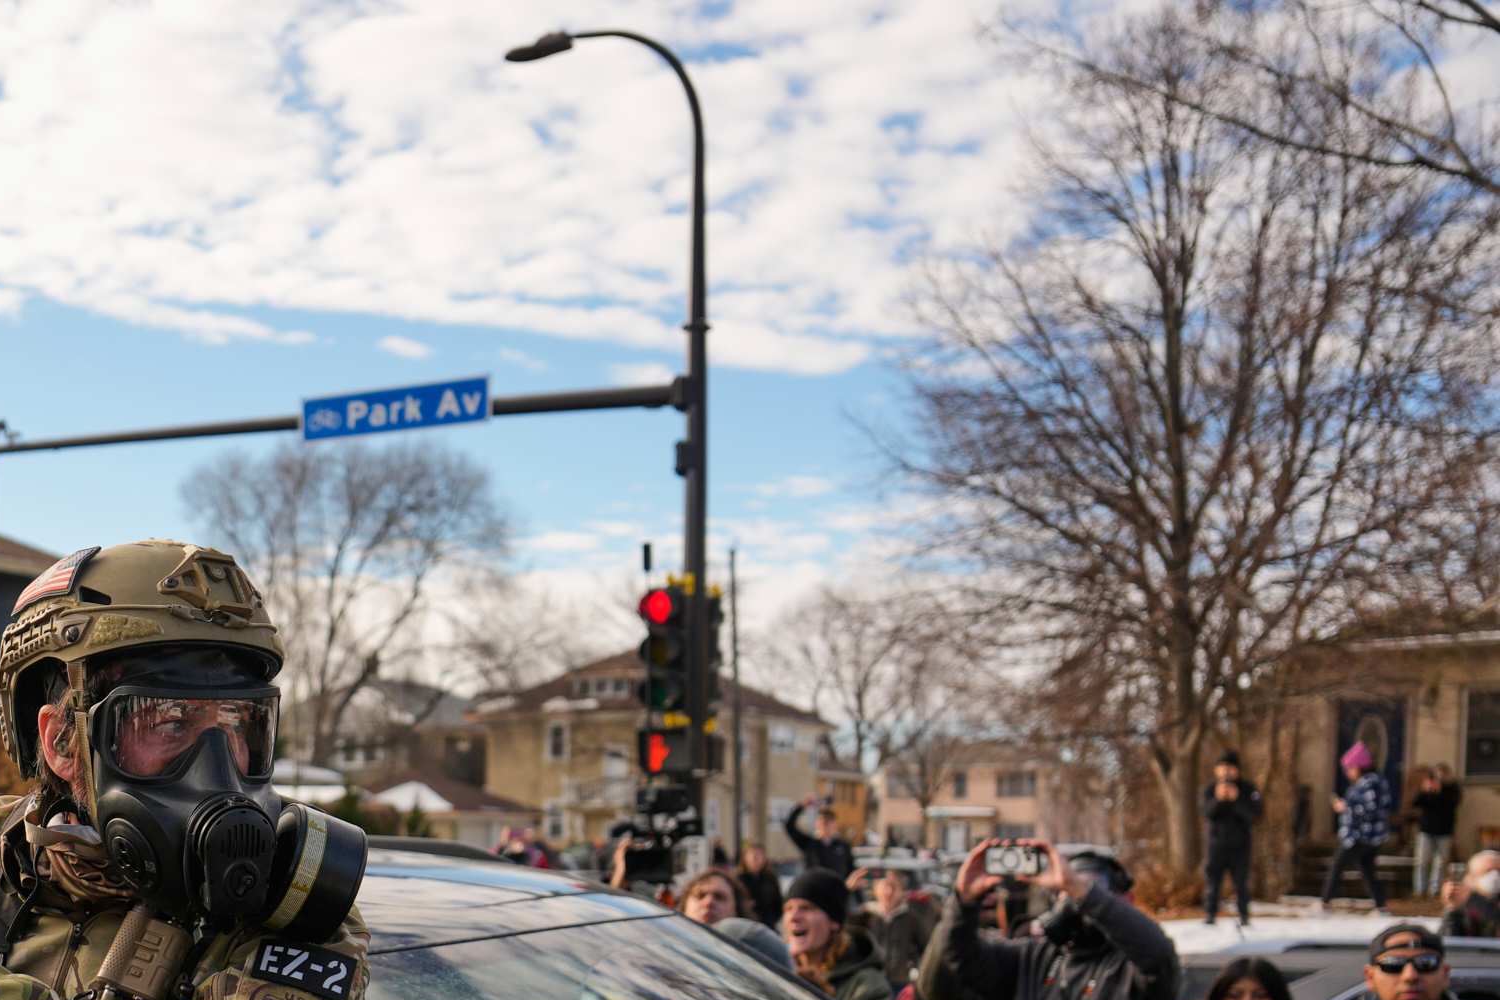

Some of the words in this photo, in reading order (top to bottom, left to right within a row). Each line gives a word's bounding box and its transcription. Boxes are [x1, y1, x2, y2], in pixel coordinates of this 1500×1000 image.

[346, 395, 422, 430] Park
[436, 388, 482, 419] Av
[260, 945, 348, 995] EZ-2
